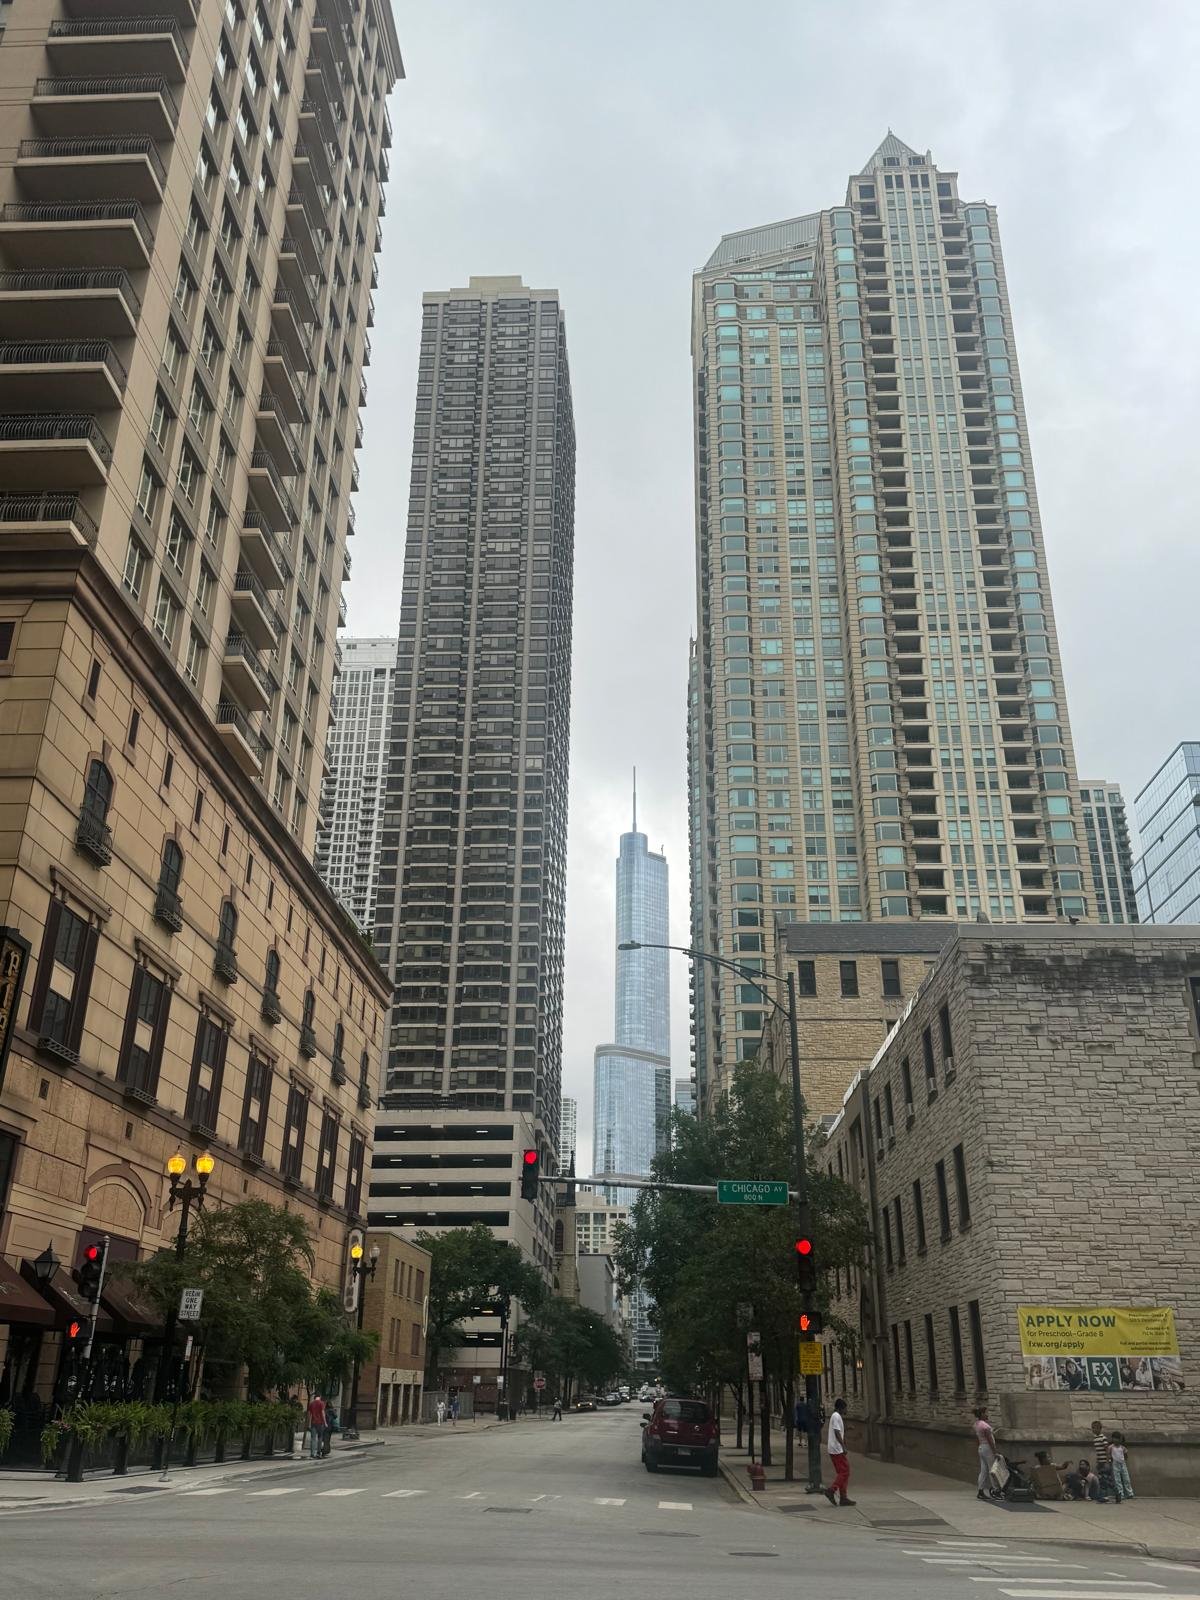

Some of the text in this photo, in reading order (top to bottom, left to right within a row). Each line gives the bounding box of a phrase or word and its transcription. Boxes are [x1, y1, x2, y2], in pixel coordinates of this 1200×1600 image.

[731, 1184, 770, 1193] CHICAGO
[1026, 1315, 1073, 1327] APPLY
[1078, 1315, 1116, 1327] NOW
[1028, 1341, 1085, 1350] fxw.org/apply
